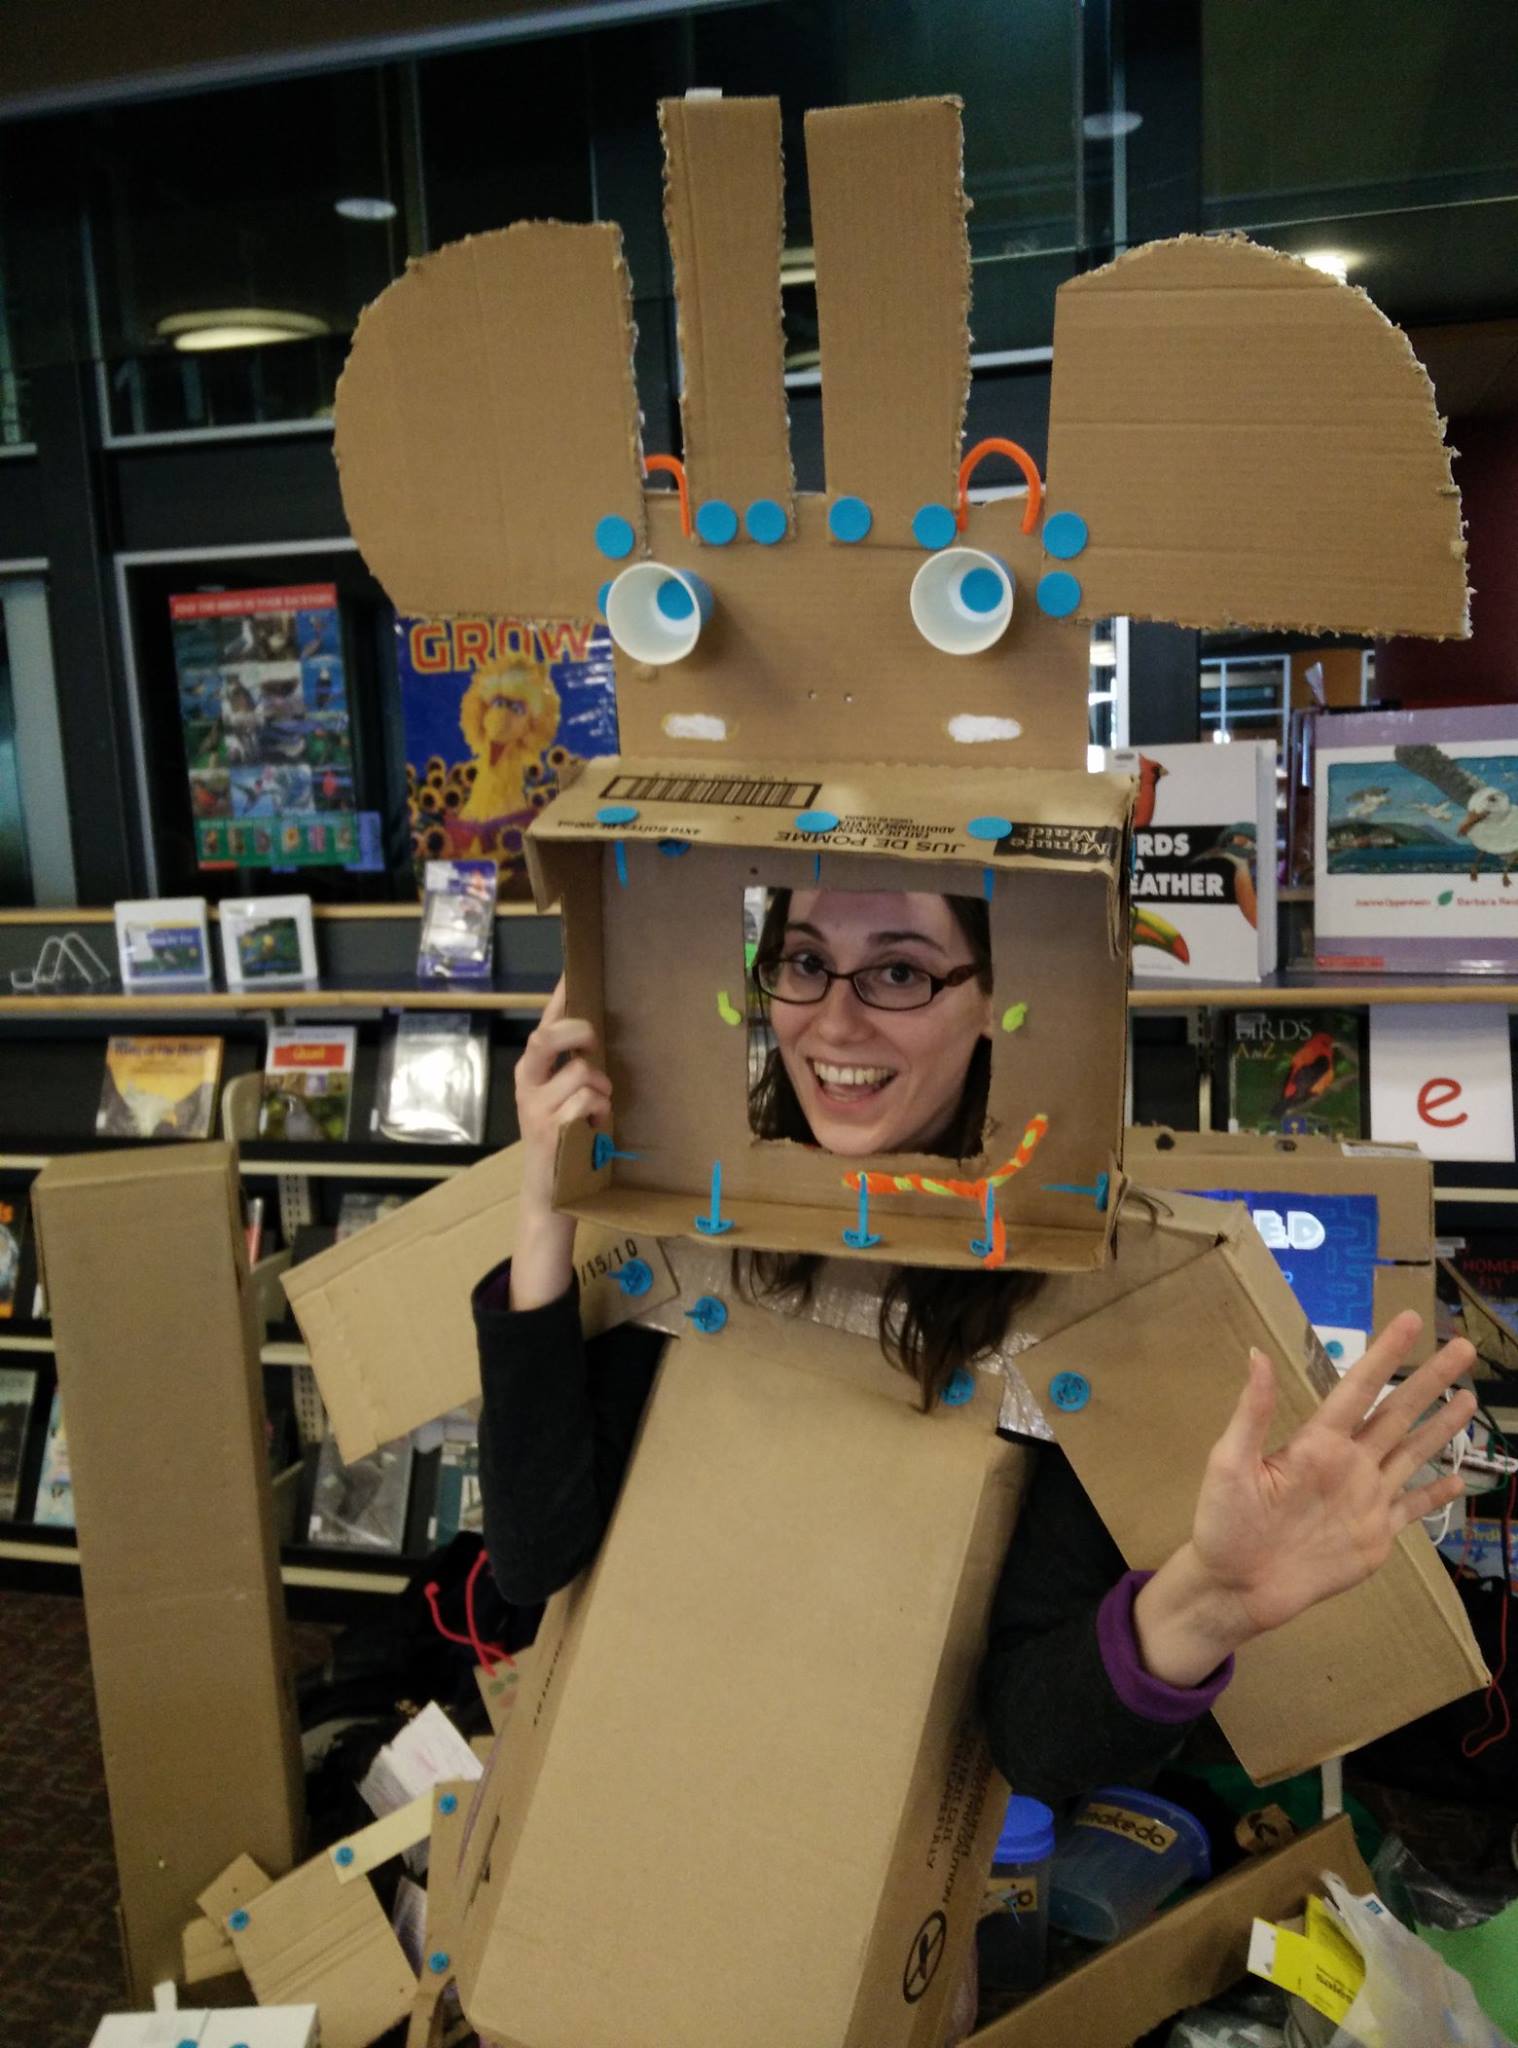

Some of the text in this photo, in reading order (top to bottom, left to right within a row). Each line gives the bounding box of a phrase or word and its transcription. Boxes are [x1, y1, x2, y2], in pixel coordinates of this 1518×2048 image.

[410, 619, 594, 674] GROW
[774, 831, 966, 854] JUS DE POMME
[1010, 838, 1109, 855] Minute
[1029, 827, 1098, 842] Maid
[1135, 833, 1190, 857] RDS
[1130, 873, 1224, 897] EATHER
[1417, 1077, 1468, 1128] e
